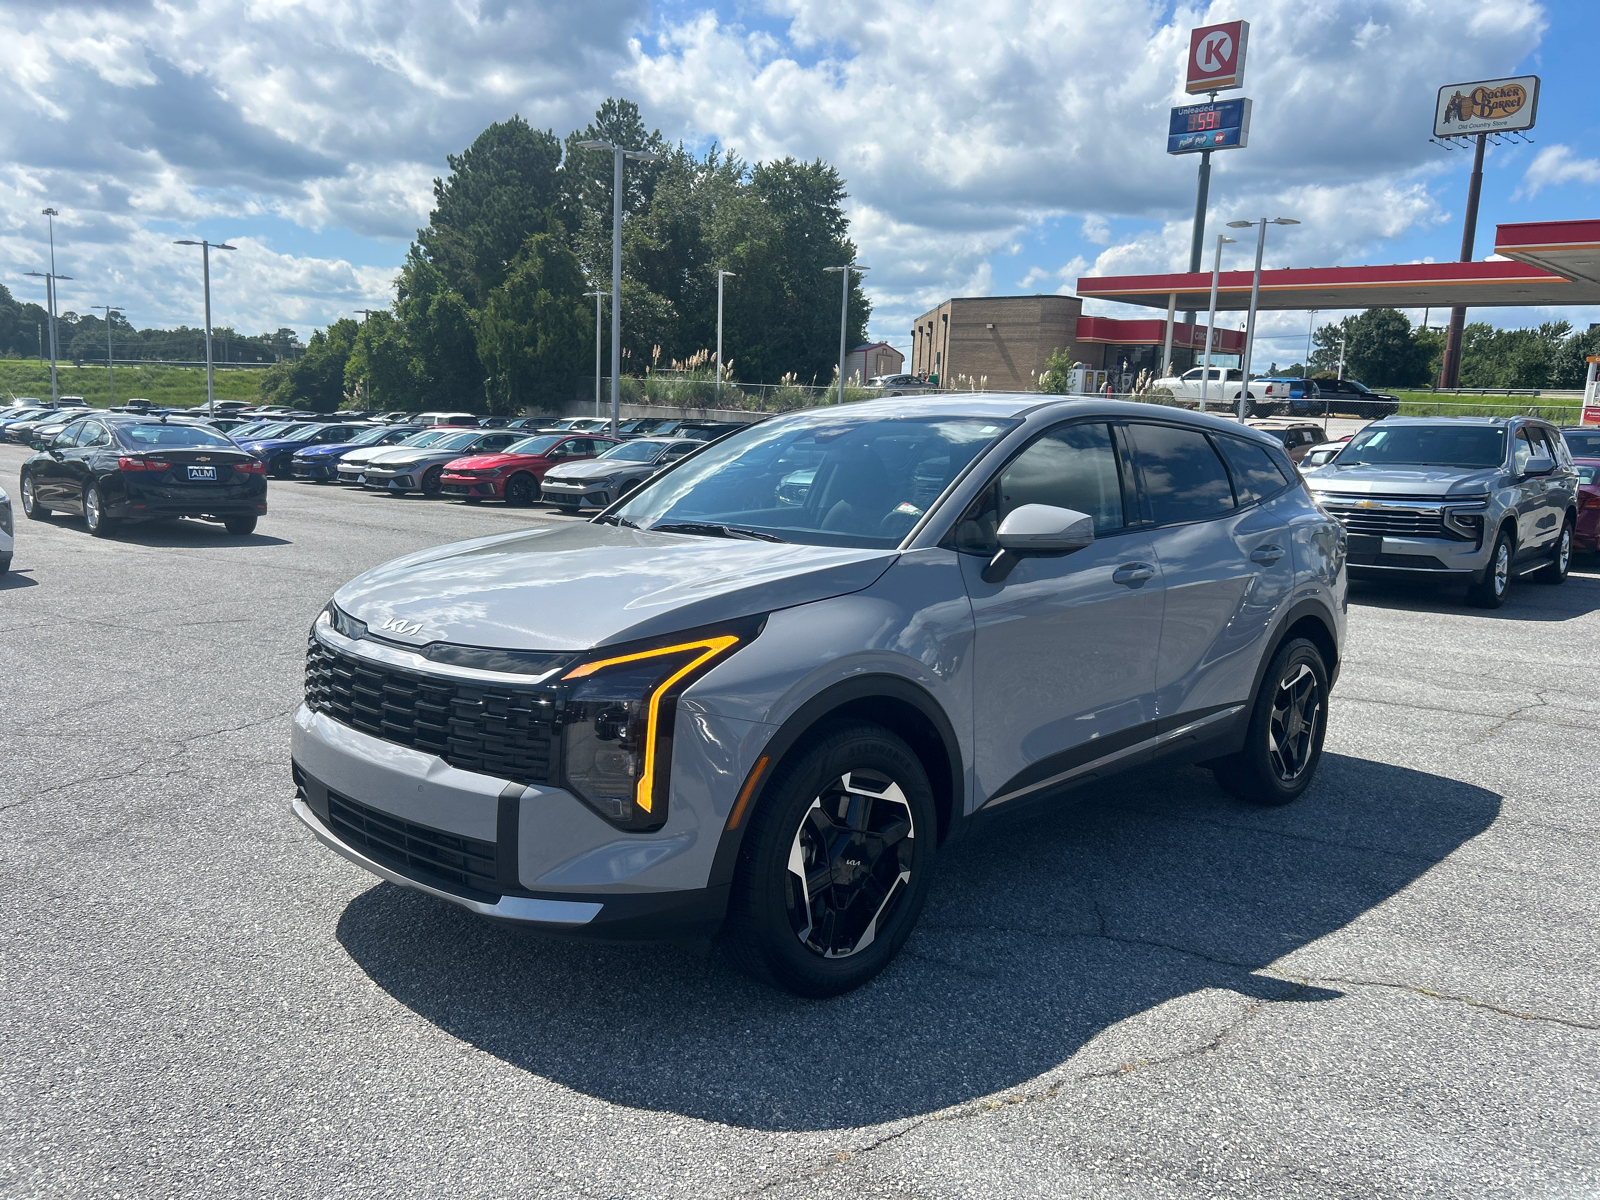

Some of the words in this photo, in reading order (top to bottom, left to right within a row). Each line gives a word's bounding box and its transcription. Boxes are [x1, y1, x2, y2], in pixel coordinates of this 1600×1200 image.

[1470, 87, 1520, 106] Cracker
[1178, 104, 1214, 116] Unleaded
[1480, 96, 1522, 117] Barrel
[1468, 121, 1491, 129] Country
[191, 469, 214, 478] ALM
